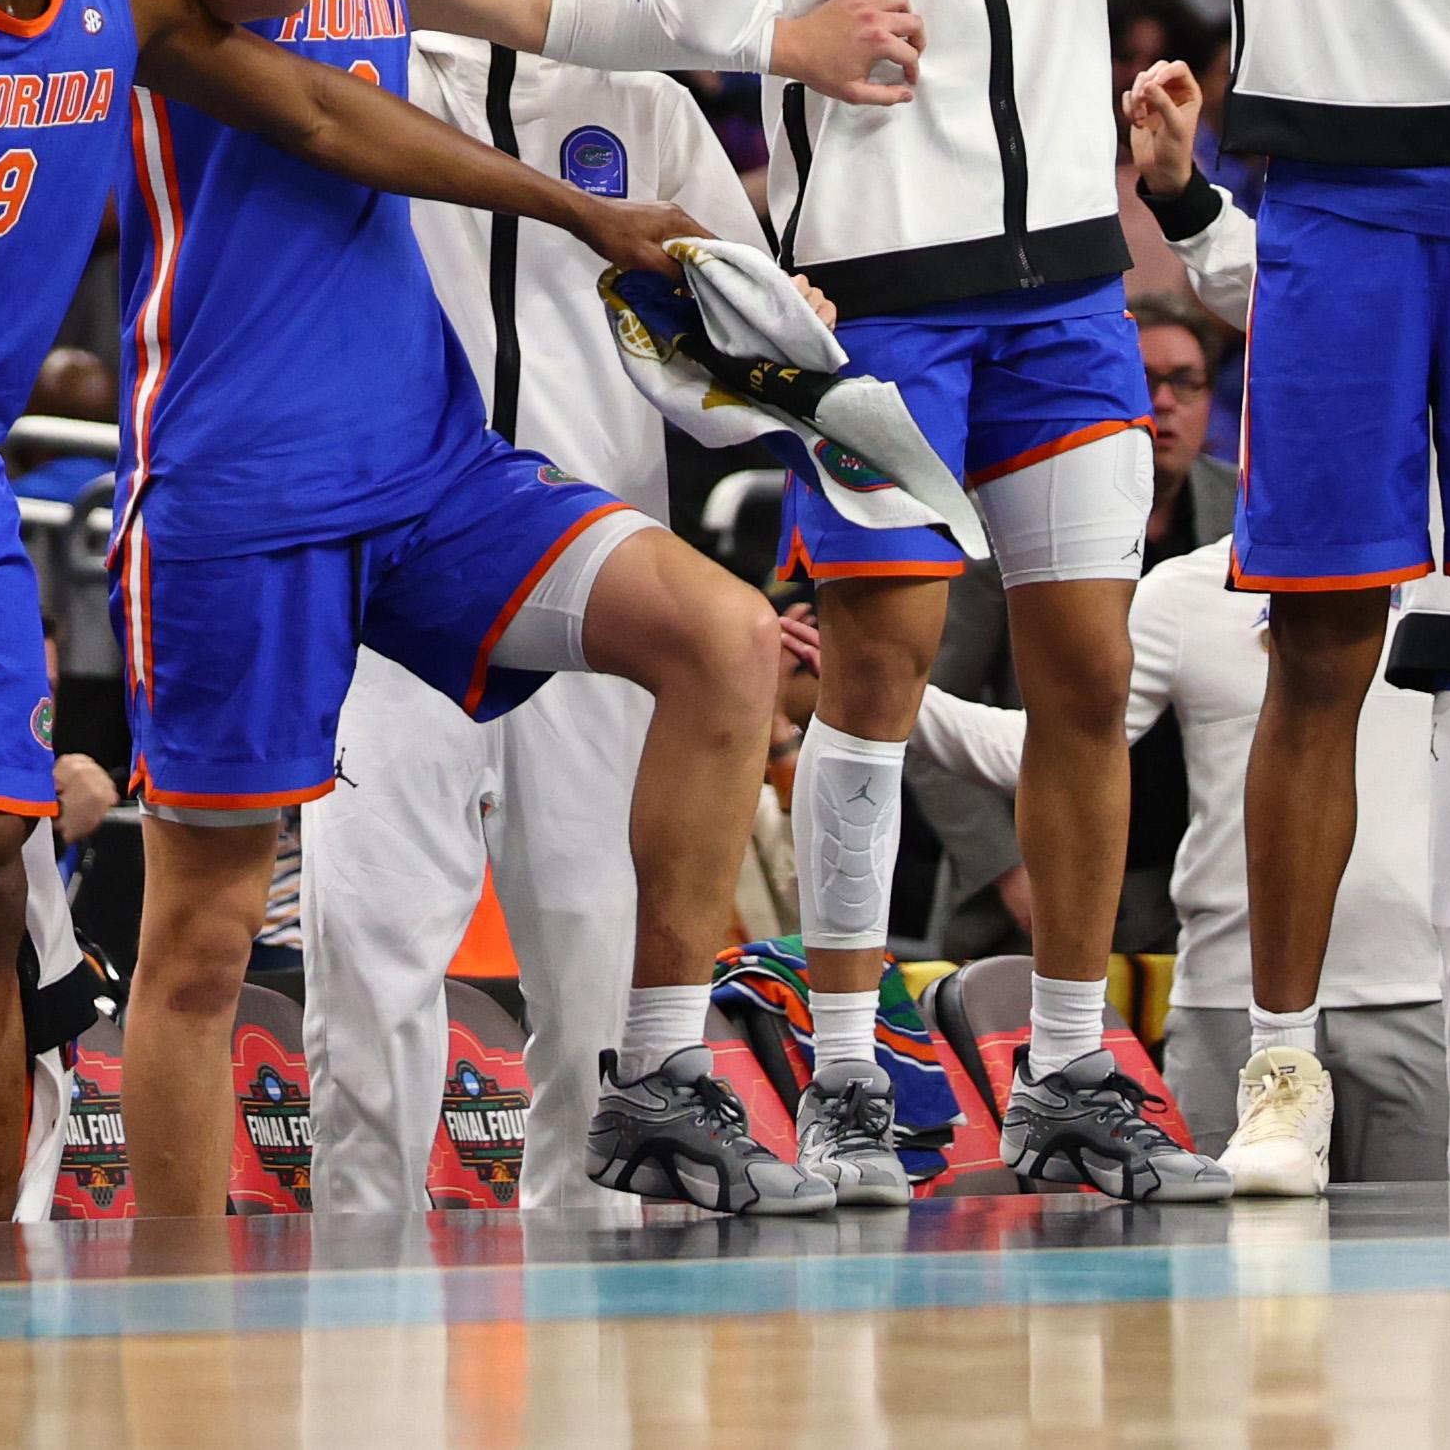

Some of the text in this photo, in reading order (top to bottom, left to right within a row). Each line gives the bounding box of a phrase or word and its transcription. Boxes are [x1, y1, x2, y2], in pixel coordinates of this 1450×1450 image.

[86, 1113, 126, 1145] FOU
[245, 1114, 314, 1147] FINAL FO
[444, 1110, 491, 1142] FINAL
